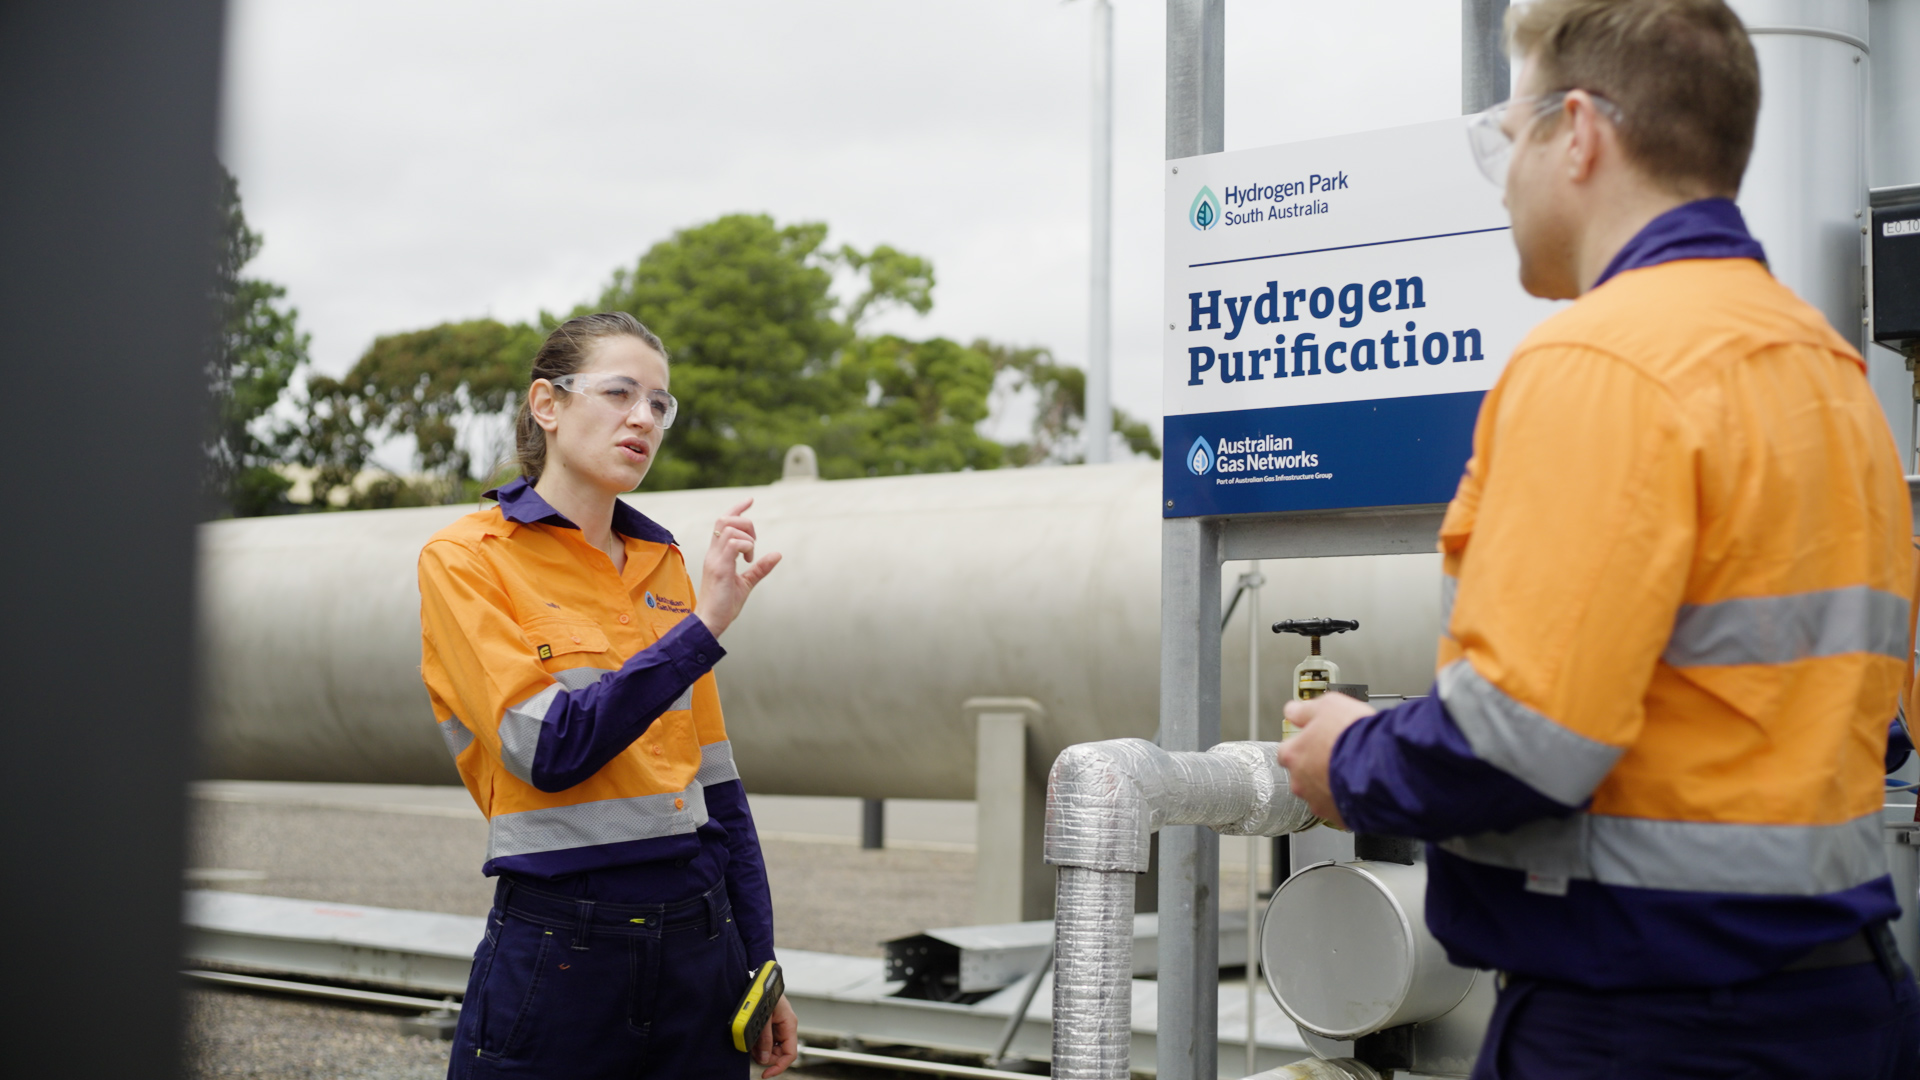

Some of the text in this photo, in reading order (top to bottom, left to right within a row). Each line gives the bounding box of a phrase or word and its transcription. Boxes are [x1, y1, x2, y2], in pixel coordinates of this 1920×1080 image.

[1225, 170, 1349, 208] Hydrogen Park
[1224, 199, 1329, 226] South Australia
[1188, 276, 1426, 341] Hydrogen
[1188, 321, 1484, 386] Purification
[1217, 434, 1293, 455] Australian
[1216, 450, 1319, 473] Gas Networks
[1235, 475, 1263, 484] Australian
[1275, 473, 1314, 481] Infrastructure
[1315, 472, 1333, 480] Group
